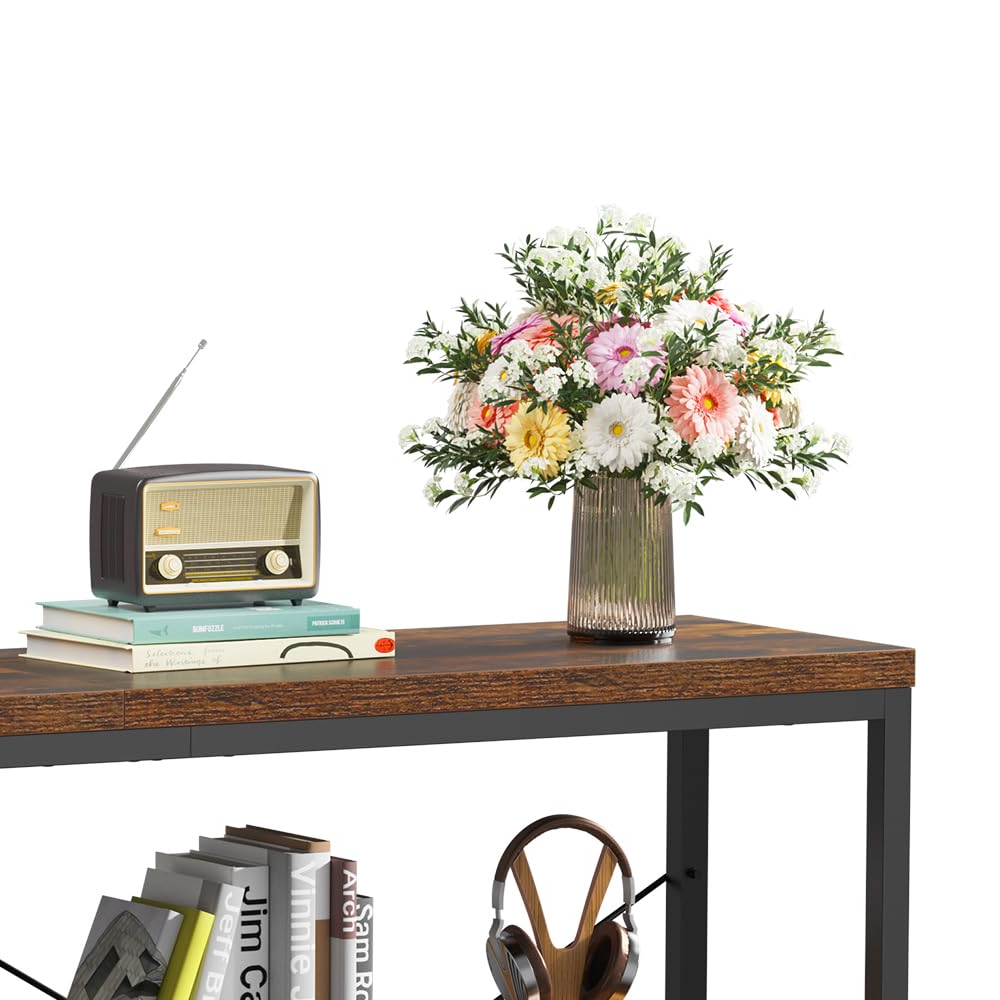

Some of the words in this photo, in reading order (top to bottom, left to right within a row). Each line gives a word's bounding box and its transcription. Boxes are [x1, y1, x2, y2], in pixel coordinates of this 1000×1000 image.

[213, 891, 241, 963] Jeff
[240, 886, 267, 952] Jim
[291, 861, 316, 975] Vinnie
[342, 869, 357, 932] Arch
[355, 903, 374, 962] Sam
